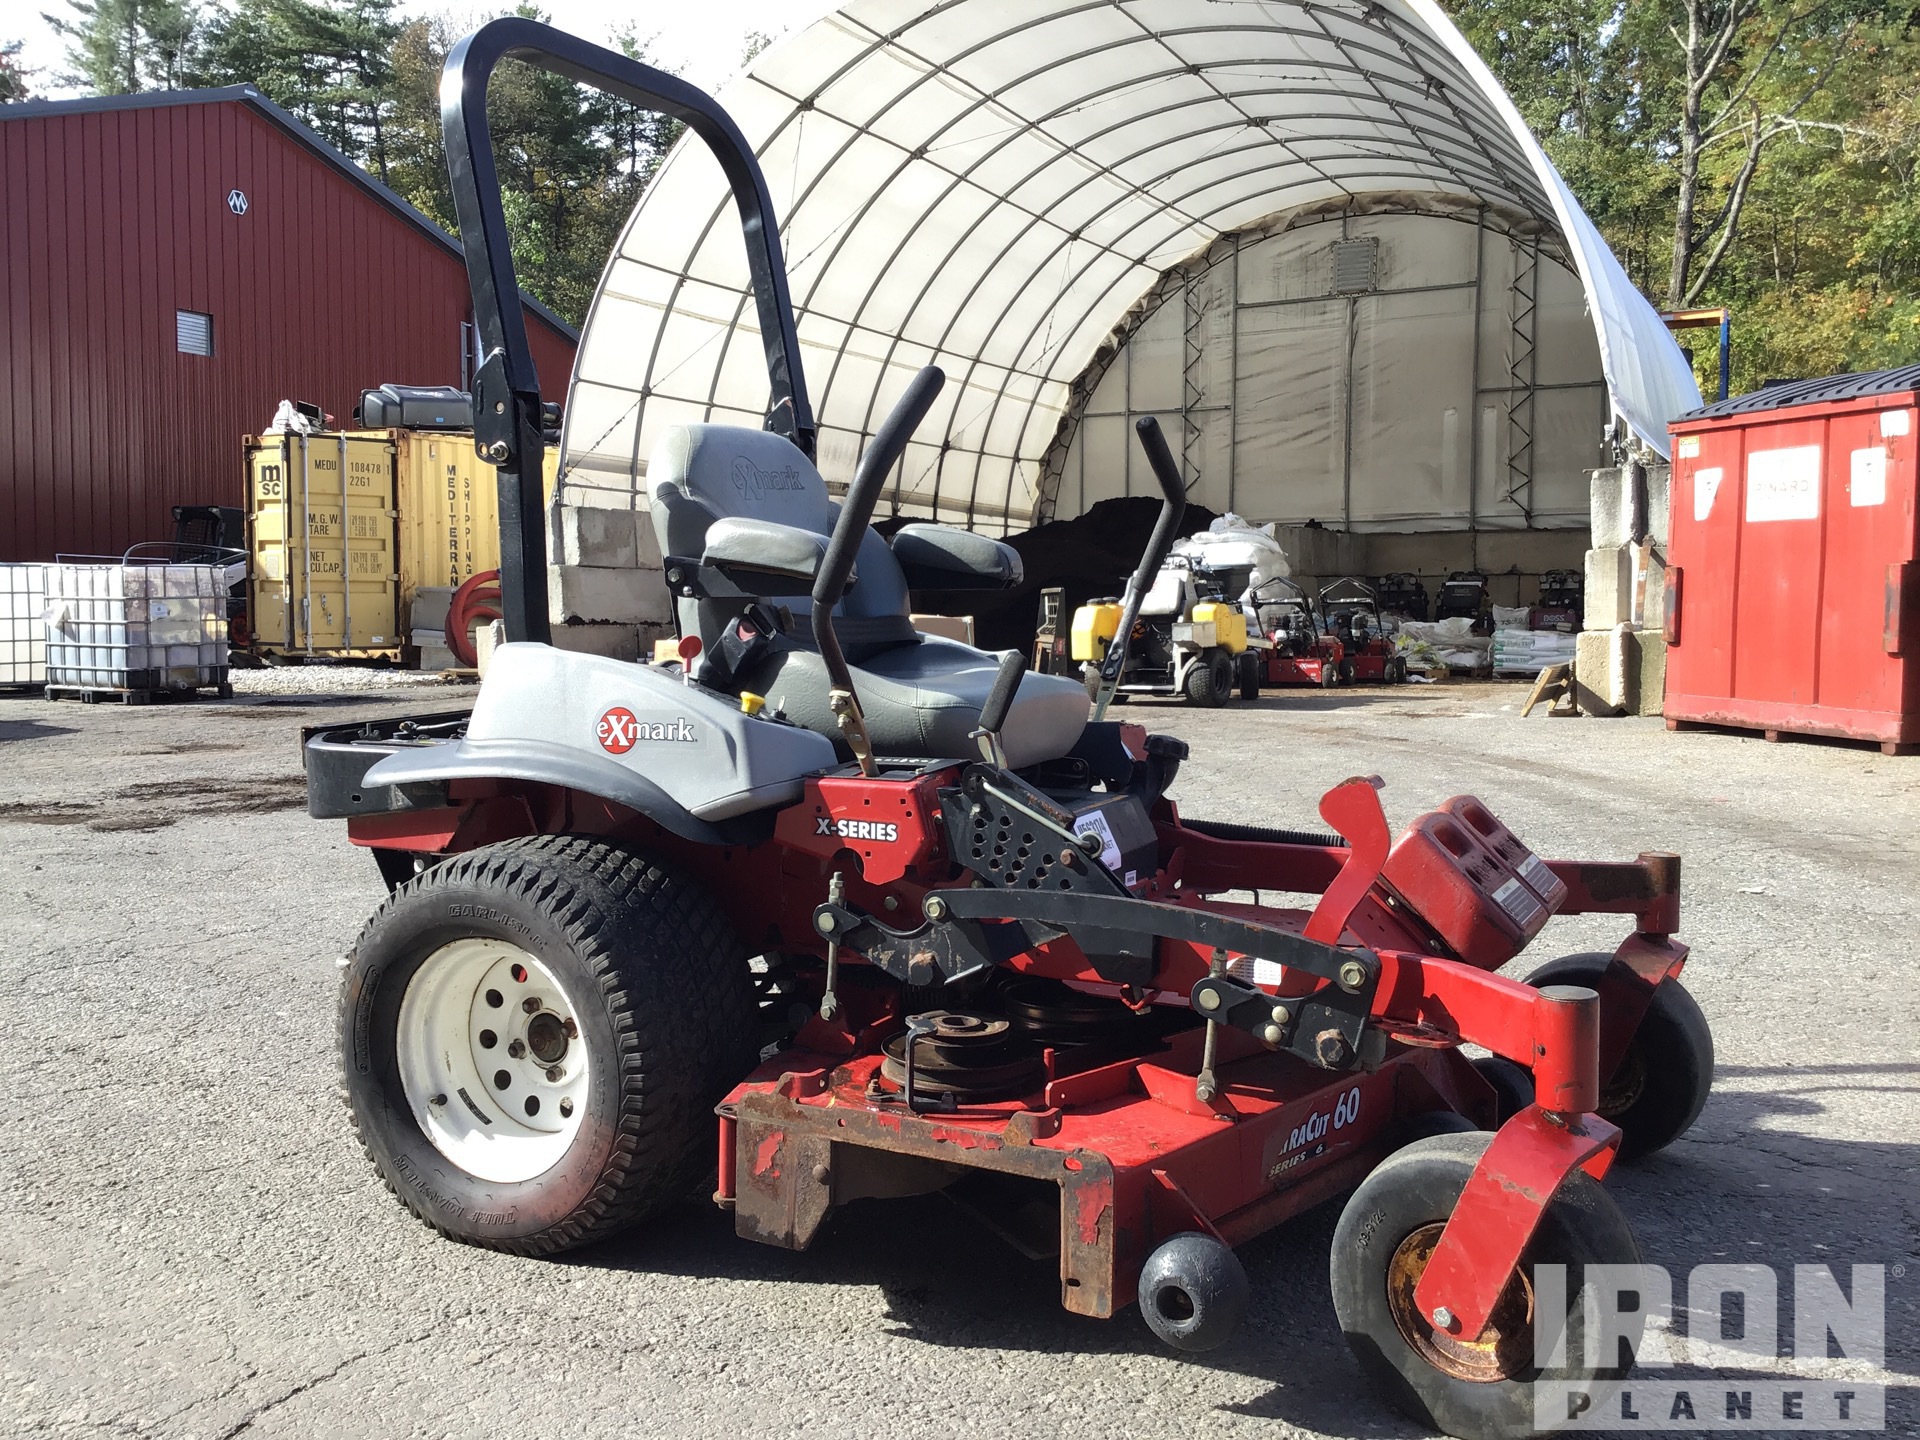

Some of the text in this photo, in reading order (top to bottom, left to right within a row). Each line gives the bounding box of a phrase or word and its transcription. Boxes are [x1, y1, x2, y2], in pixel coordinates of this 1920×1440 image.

[314, 459, 337, 471] MEDU
[350, 461, 381, 474] 108478
[349, 476, 370, 487] 22G1
[309, 525, 330, 536] TARE
[446, 465, 459, 587] MEDITERRAN
[310, 551, 325, 562] NET
[596, 711, 695, 748] eXmark
[815, 817, 899, 842] X-SERIES
[1333, 1086, 1361, 1130] 60
